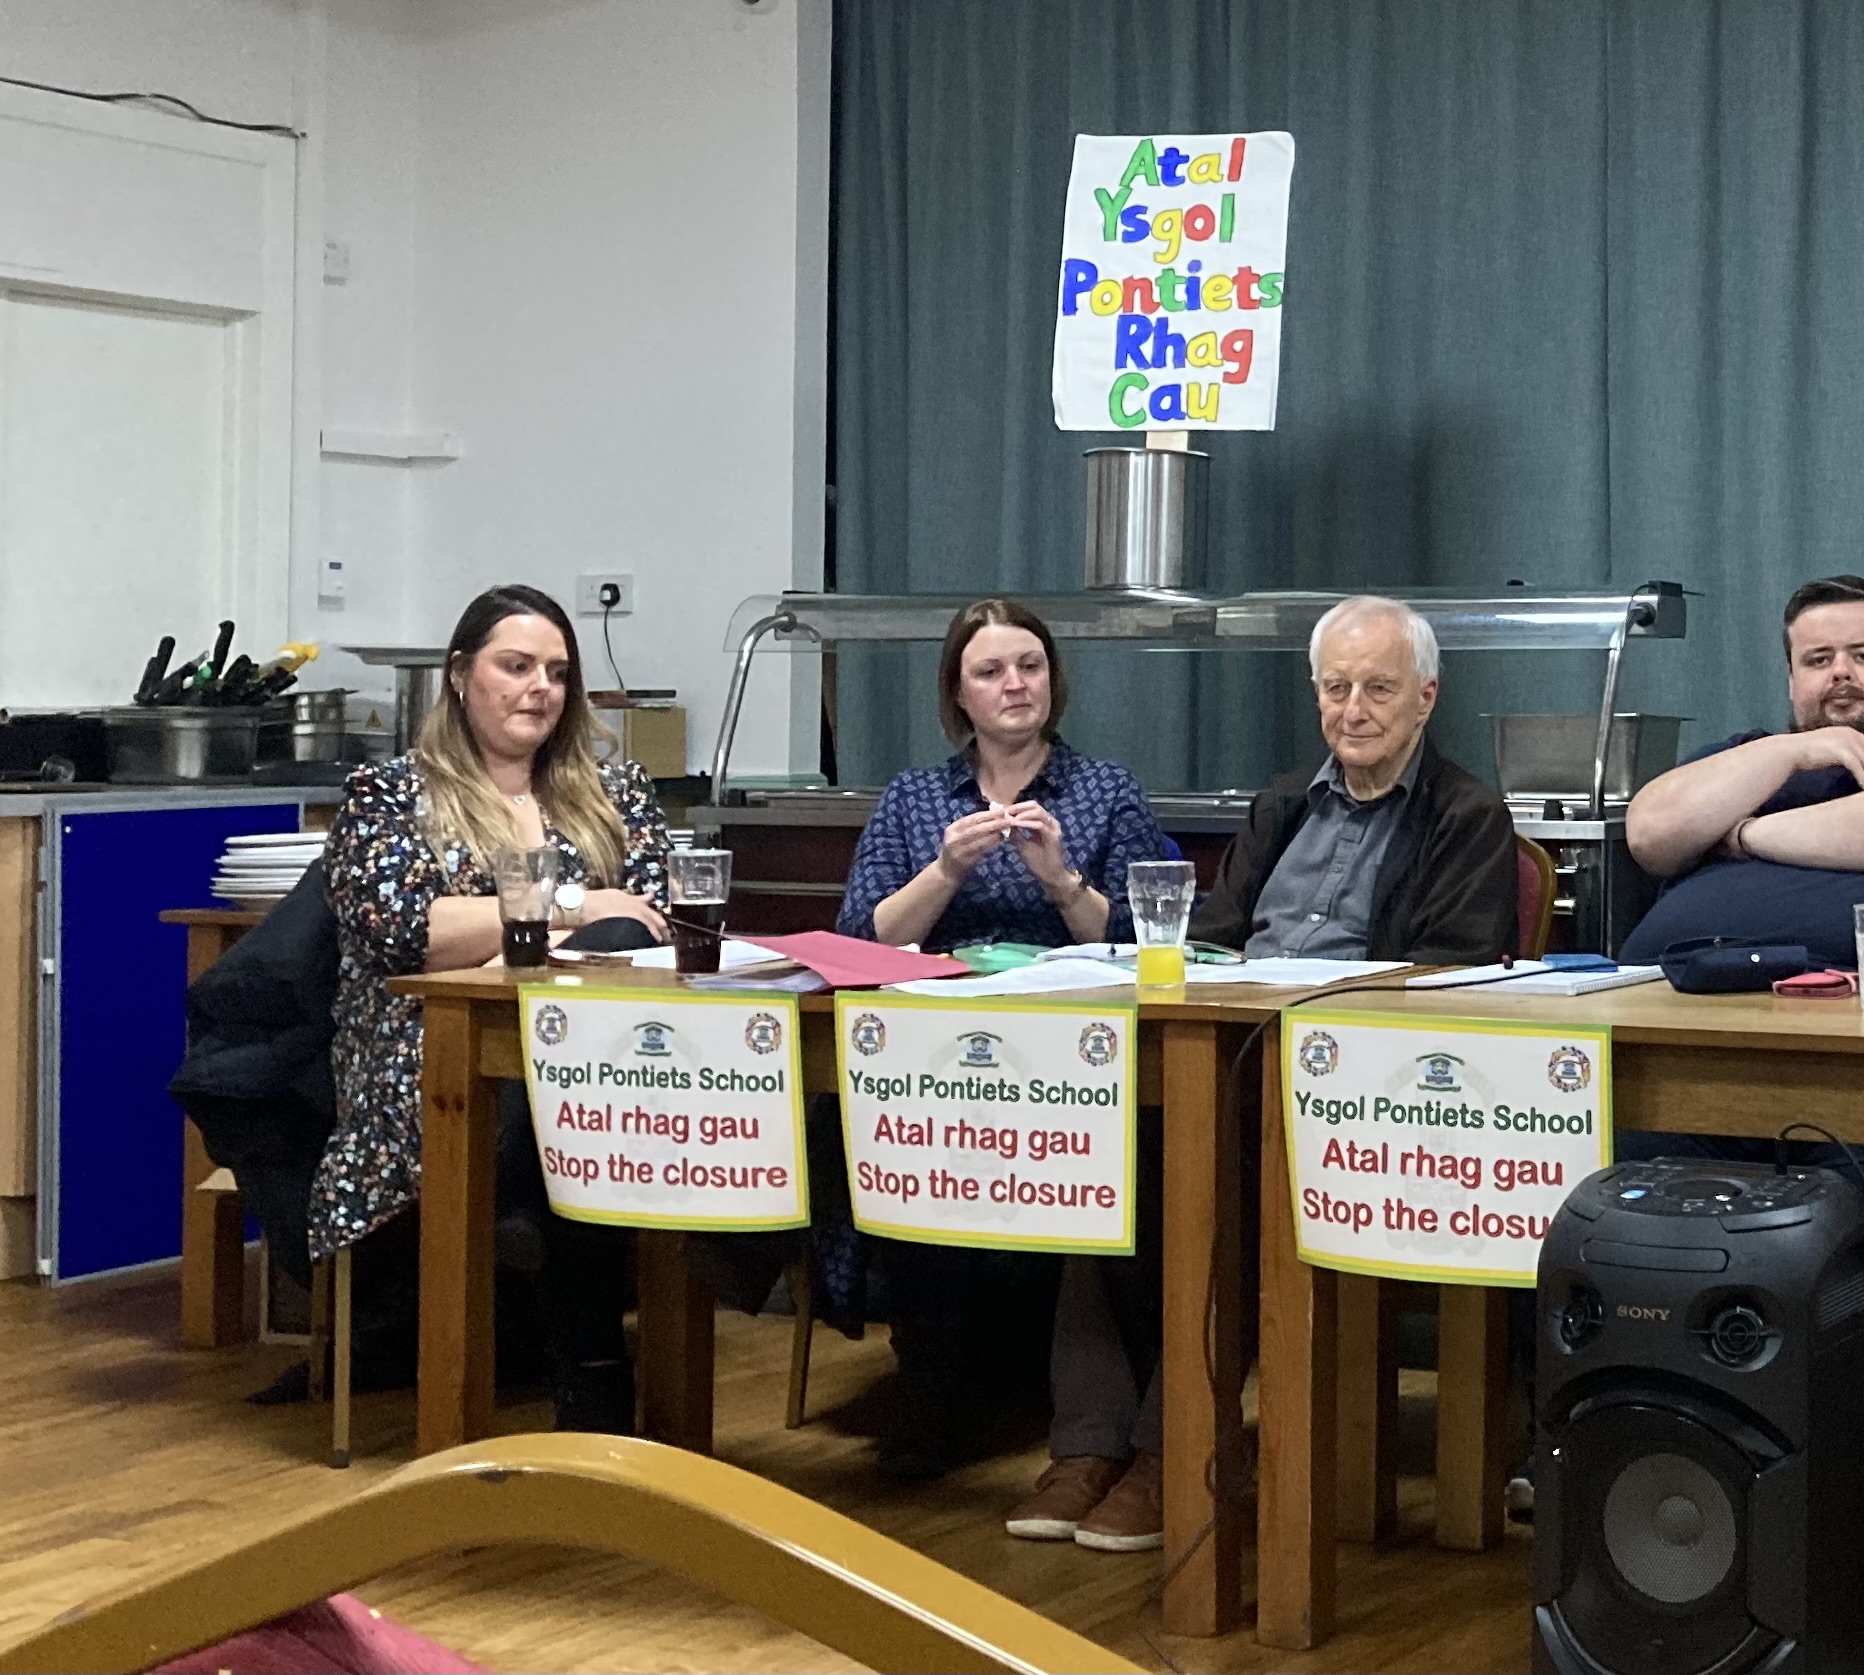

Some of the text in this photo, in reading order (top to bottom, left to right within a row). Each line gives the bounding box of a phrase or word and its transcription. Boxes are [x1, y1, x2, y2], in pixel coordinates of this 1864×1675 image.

[1119, 138, 1246, 186] Atal
[1094, 186, 1235, 264] Ysgol
[1062, 258, 1284, 316] Pontiets
[1115, 315, 1253, 384] Rhag
[1109, 372, 1220, 428] Cau
[534, 1059, 784, 1093] Ysgol Pontiets School
[849, 1070, 1117, 1106] Ysgol Pontiets School
[557, 1101, 759, 1145] Atal rhag gau
[1295, 1092, 1592, 1135] Ysgol Pontiets School
[874, 1114, 1090, 1161] Atal rhag gau
[545, 1148, 787, 1189] Stop the closure
[858, 1162, 1116, 1208] Stop the closure
[1323, 1138, 1562, 1191] Atal rhag gau
[1303, 1188, 1549, 1239] Stop the closu
[1617, 1306, 1670, 1320] SONY
